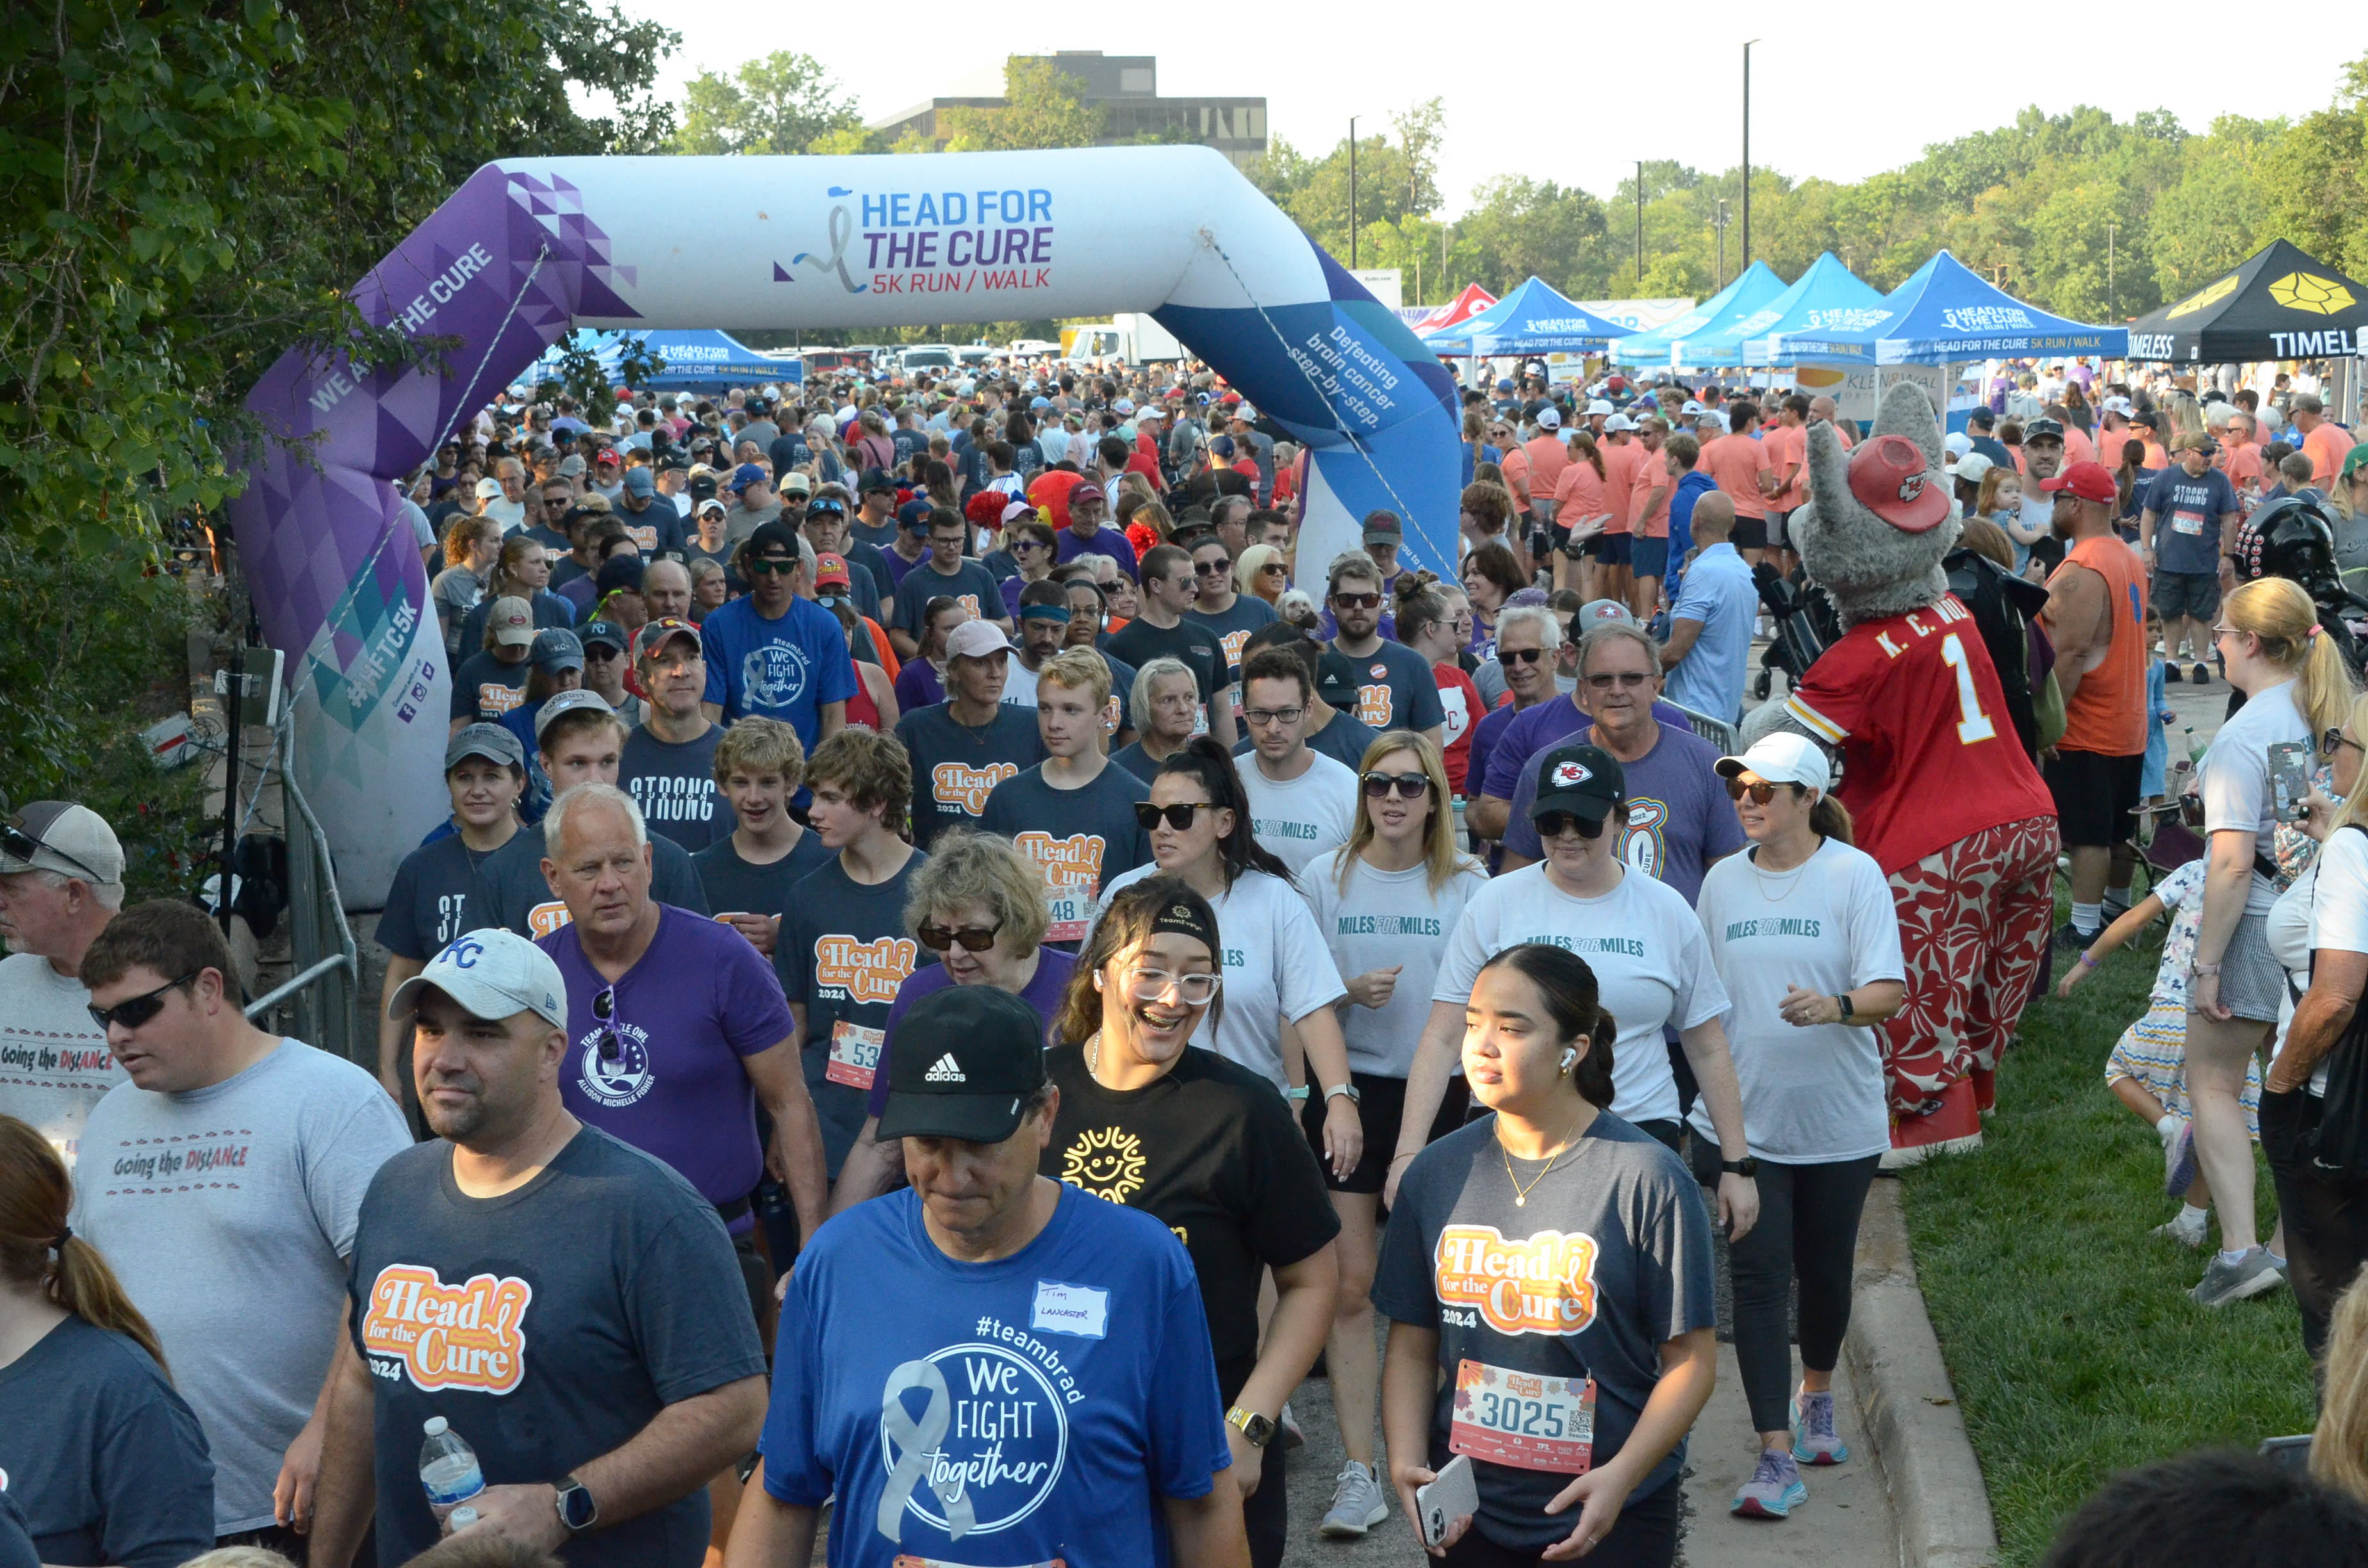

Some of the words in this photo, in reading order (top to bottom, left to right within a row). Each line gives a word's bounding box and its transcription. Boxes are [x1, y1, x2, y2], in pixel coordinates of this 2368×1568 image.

[862, 193, 967, 227] HEAD
[977, 189, 1052, 224] FOR
[863, 231, 939, 269] THE
[948, 227, 1053, 267] CURE
[873, 274, 903, 294] 5K
[910, 272, 960, 293] RUN
[983, 268, 1051, 290] WALK
[1957, 307, 1996, 317] HEAD
[2000, 307, 2025, 317] FOR
[1961, 316, 1989, 325] THE
[1993, 316, 2031, 324] CURE
[308, 372, 353, 412] WE
[429, 242, 493, 304] CURE
[1515, 339, 1534, 348] HEAD
[1563, 338, 1583, 346] CURE
[1934, 340, 1961, 352] HEAD
[1962, 340, 1982, 351] FOR
[1982, 339, 2002, 350] THE
[2002, 338, 2028, 350] CURE
[2031, 338, 2044, 348] 5K
[2046, 338, 2066, 348] RUN
[2074, 336, 2101, 348] WALK
[2128, 334, 2175, 359] IMELESS
[2270, 330, 2356, 357] TIMEL
[677, 365, 693, 373] THE
[694, 365, 716, 374] CURE
[1329, 325, 1399, 391] Defeating
[1306, 333, 1346, 371] brain
[1344, 368, 1395, 410] cancer
[1290, 348, 1379, 429] step-by-step.
[818, 564, 841, 574] CHIEFS
[1875, 630, 1909, 659] K.
[1905, 613, 1937, 637] C.
[1929, 597, 1970, 625] WOL
[347, 598, 417, 708] #HFTC5K
[770, 651, 789, 663] We
[773, 637, 811, 665] #teambrad
[768, 664, 794, 677] FIGHT
[759, 677, 799, 697] together
[1940, 632, 1997, 745] 1
[1361, 710, 1386, 721] ure
[939, 769, 997, 788] Head
[939, 788, 952, 797] for
[953, 788, 966, 797] the
[937, 804, 961, 813] 2024
[1630, 813, 1647, 822] 2022
[1021, 840, 1080, 863] Head
[1643, 853, 1652, 873] CURE
[1046, 862, 1098, 886] Cure
[439, 936, 484, 969] KC
[822, 943, 887, 969] Head
[822, 967, 836, 978] for
[837, 968, 852, 978] the
[819, 990, 845, 1000] 2024
[580, 1027, 602, 1047] TEAM
[632, 1026, 649, 1043] OWL
[1, 1044, 36, 1071] Going
[38, 1047, 58, 1071] the
[925, 1070, 966, 1082] adidas
[577, 1079, 602, 1103] ALLISON
[603, 1095, 637, 1107] MICHELLE
[636, 1074, 655, 1098] FISHER
[114, 1153, 156, 1180] Going
[158, 1150, 182, 1176] the
[1444, 1238, 1552, 1281] Head
[379, 1279, 486, 1329] Head
[1041, 1287, 1066, 1300] Tim
[1442, 1276, 1459, 1292] for
[1463, 1277, 1488, 1293] the
[1490, 1279, 1582, 1321] Cure
[1041, 1307, 1088, 1320] LANCASTER
[1442, 1309, 1477, 1328] 2024
[368, 1319, 390, 1339] for
[391, 1324, 416, 1343] the
[416, 1327, 509, 1378] Cure
[976, 1316, 1085, 1405] #teambrad
[965, 1357, 1019, 1395] We
[957, 1400, 1037, 1441] FIGHT
[1481, 1392, 1564, 1438] 3025
[921, 1441, 1048, 1503] together
